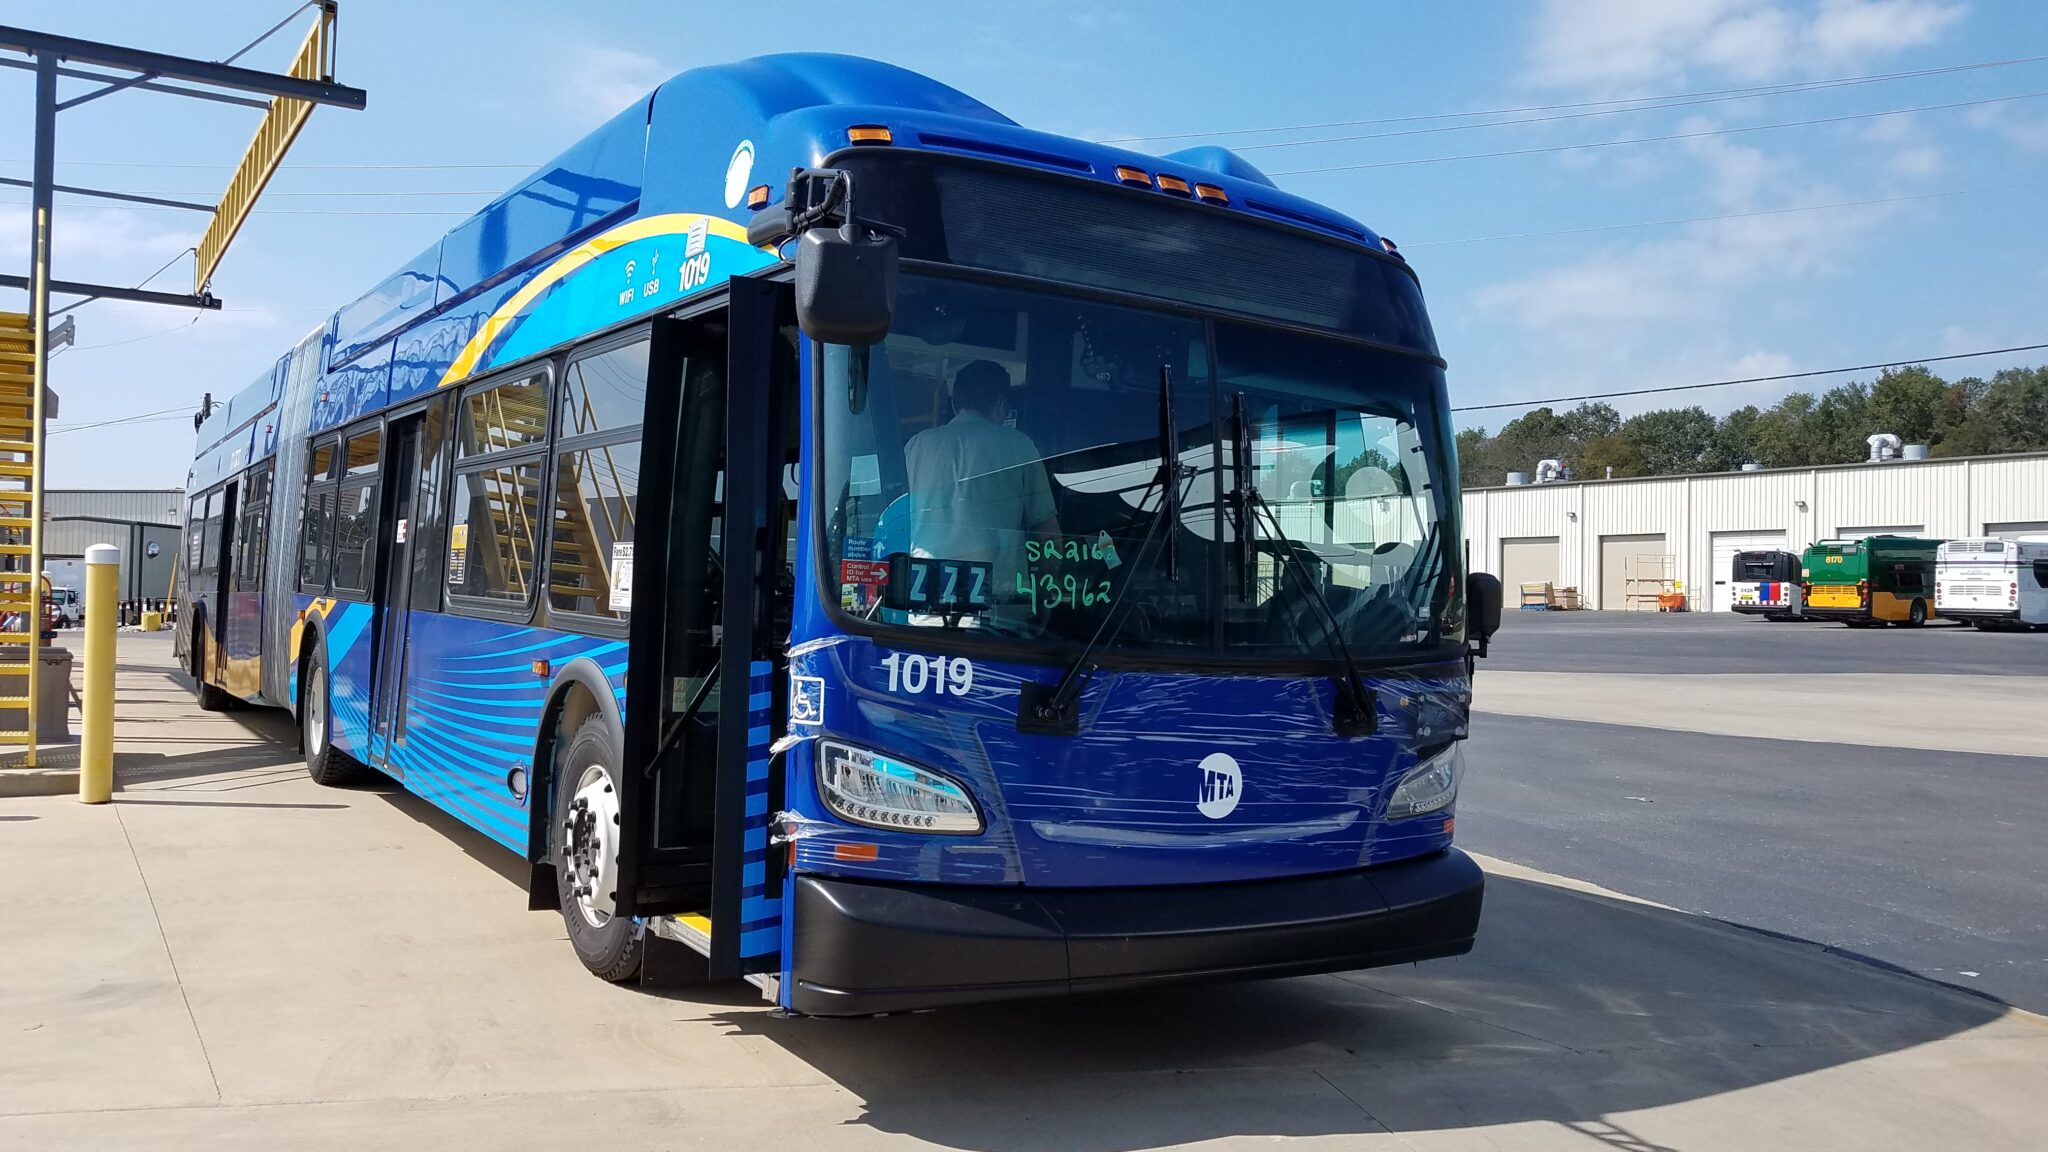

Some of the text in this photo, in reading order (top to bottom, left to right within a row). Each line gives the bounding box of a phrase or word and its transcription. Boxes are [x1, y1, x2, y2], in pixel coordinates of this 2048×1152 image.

[643, 278, 660, 298] USB
[679, 252, 711, 292] 1019
[622, 546, 633, 557] $2.7
[1825, 556, 1843, 564] 8170
[1016, 572, 1111, 615] 43962
[881, 653, 973, 696] 1019
[1197, 768, 1234, 804] MTA
